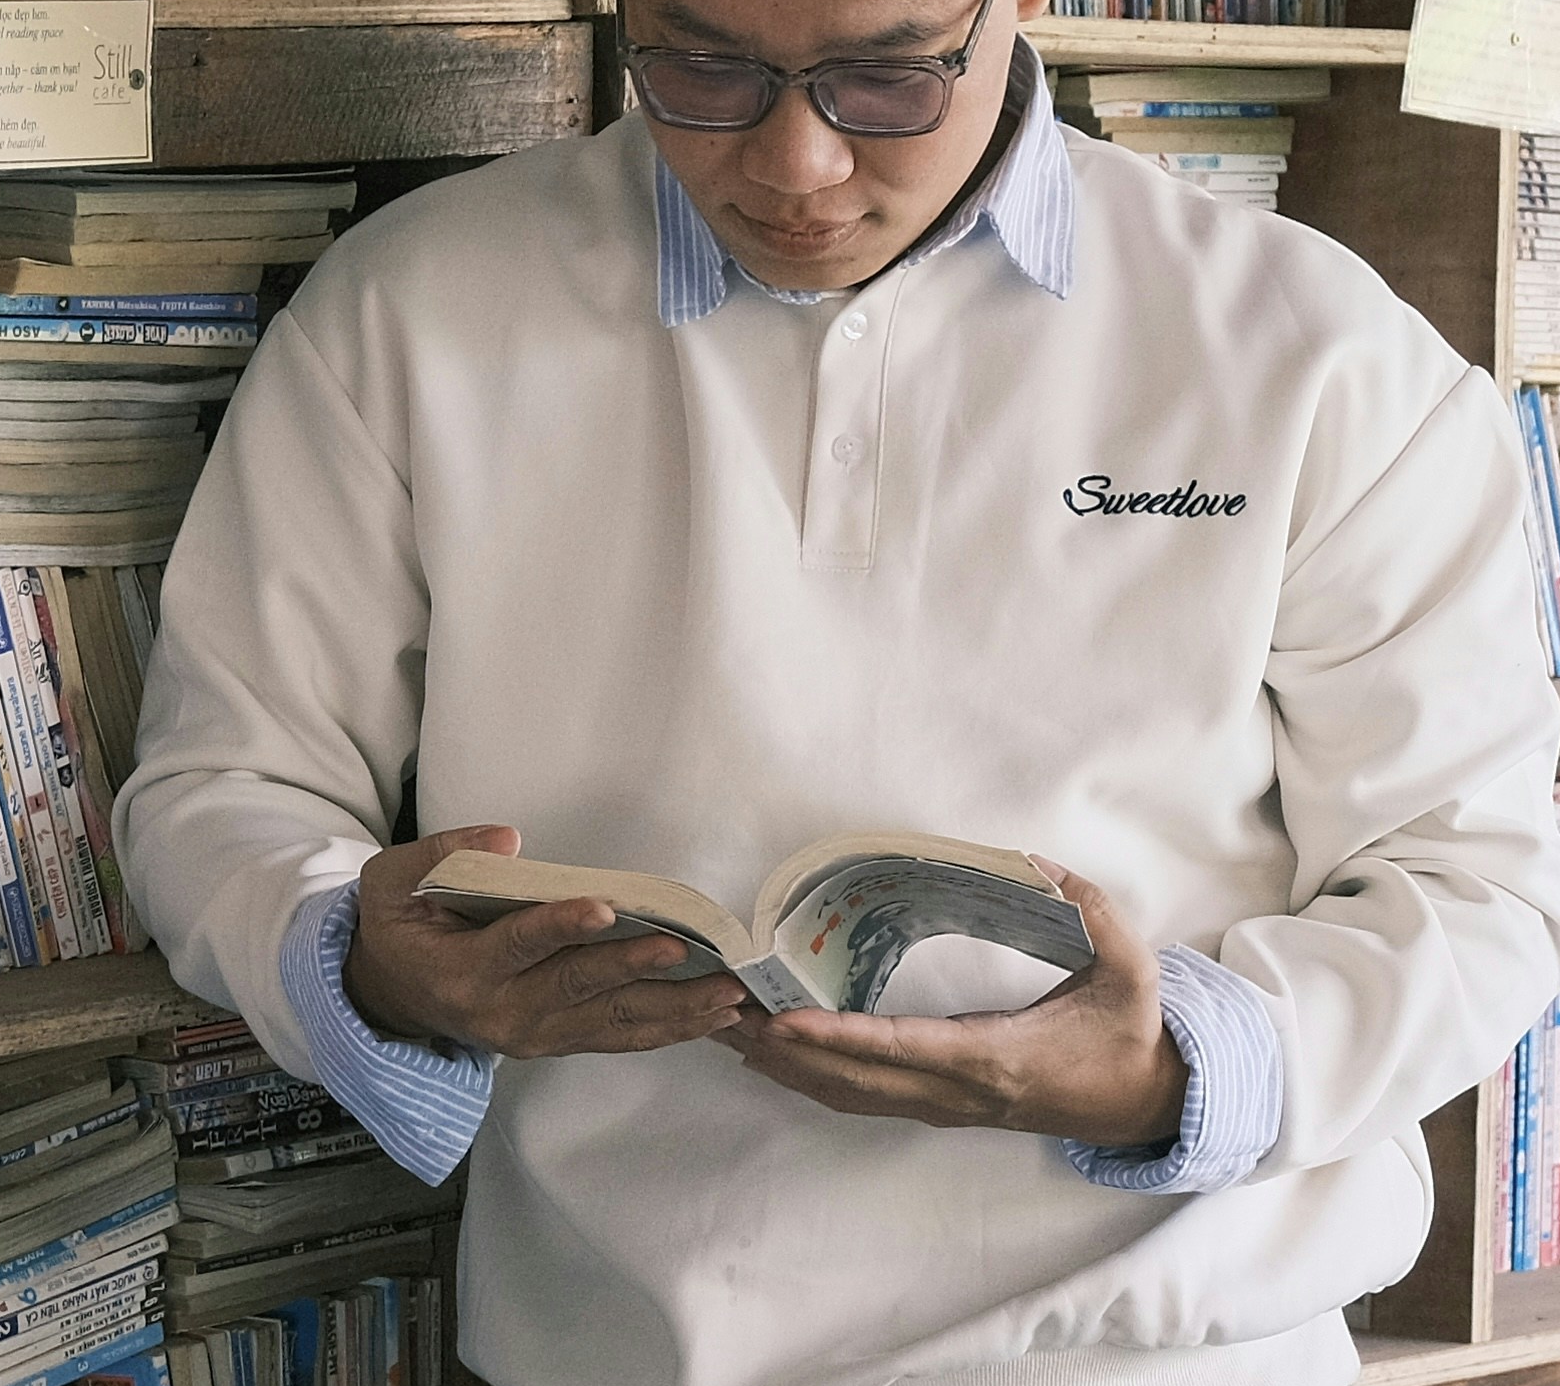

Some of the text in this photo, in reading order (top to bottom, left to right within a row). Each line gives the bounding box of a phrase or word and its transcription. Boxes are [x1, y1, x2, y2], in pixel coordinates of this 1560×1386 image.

[14, 8, 30, 25] đẹp
[6, 27, 38, 41] reading
[93, 44, 132, 80] Still
[34, 83, 58, 94] thank
[59, 81, 78, 95] you!
[1063, 475, 1246, 518] Sweetlove
